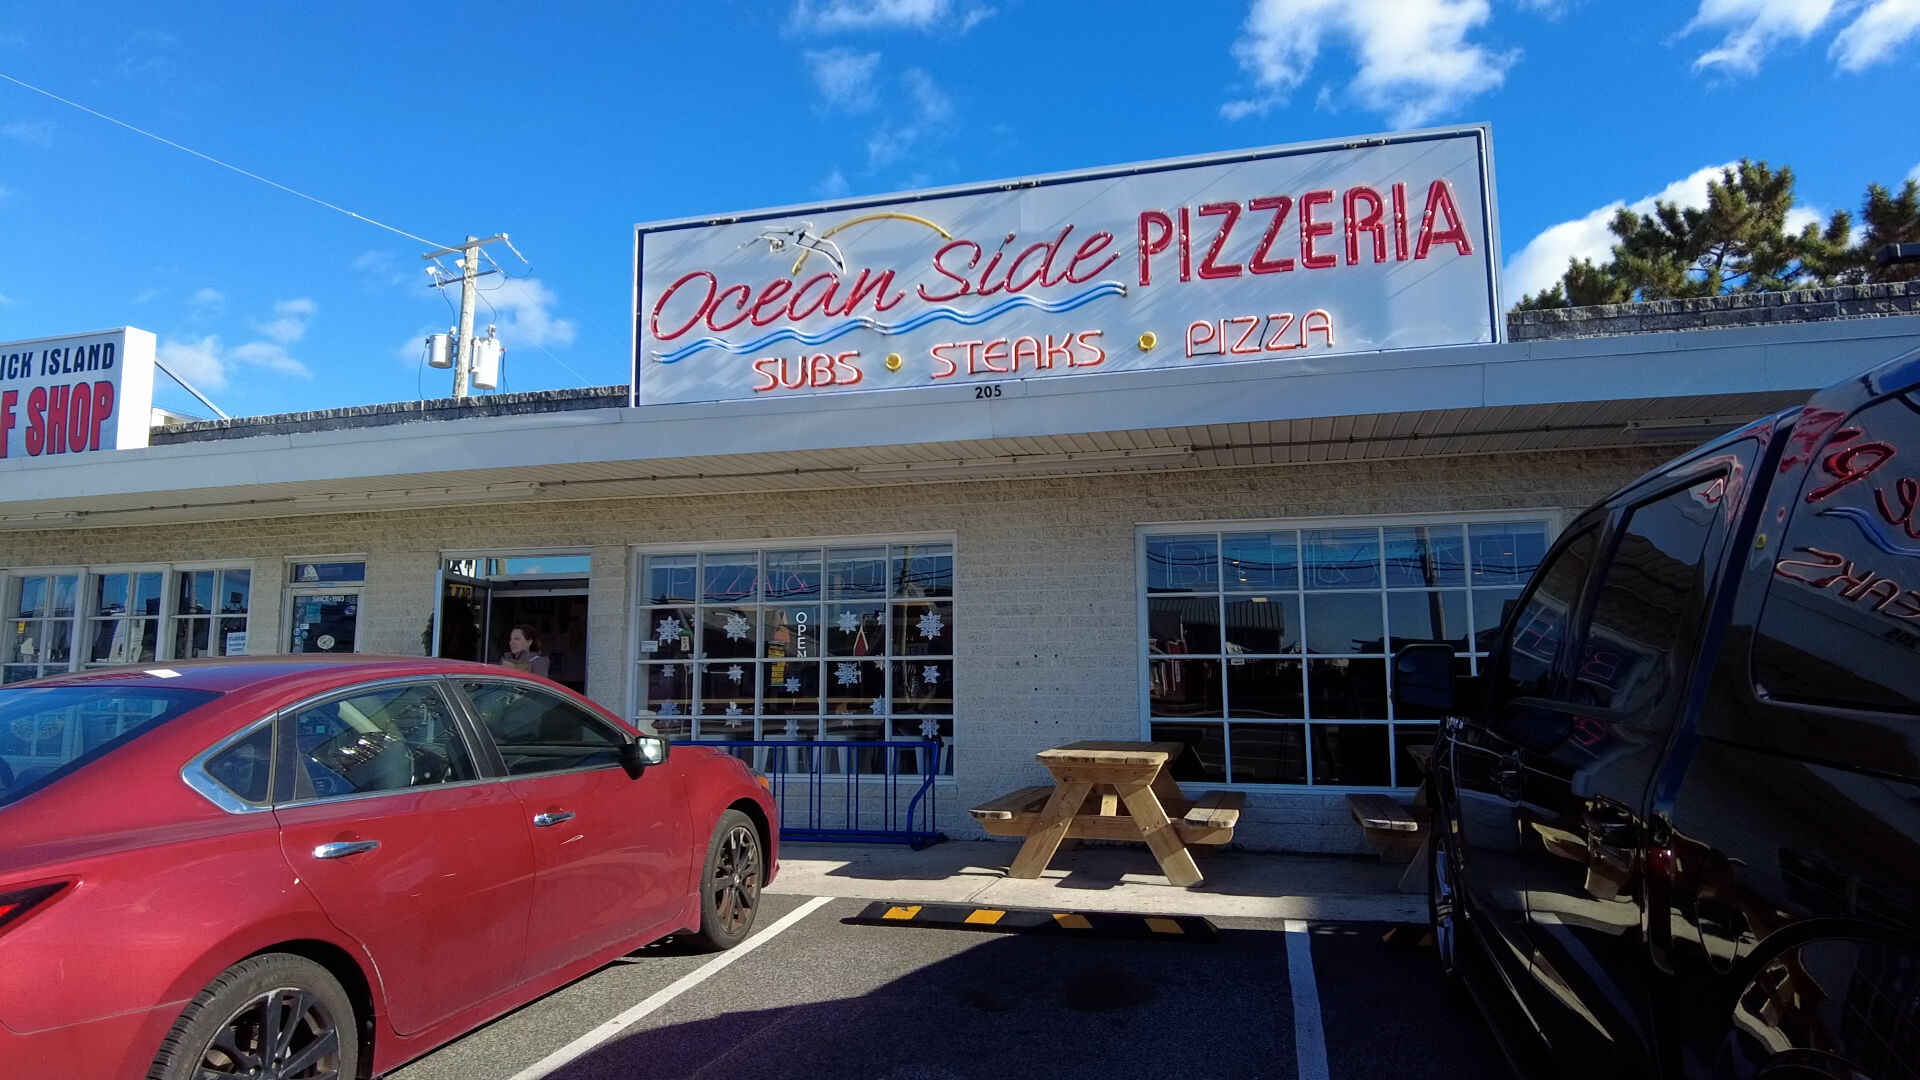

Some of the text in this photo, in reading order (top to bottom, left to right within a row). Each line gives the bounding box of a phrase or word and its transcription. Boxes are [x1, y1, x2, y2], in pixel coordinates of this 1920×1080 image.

[650, 178, 1475, 341] Ocean Side PIZZERIA
[40, 342, 115, 377] ISLAND
[752, 308, 1336, 392] SUBS STEAKS PIZZA
[25, 380, 115, 457] SHOP
[975, 385, 1002, 399] 205
[795, 611, 808, 658] OPEN
